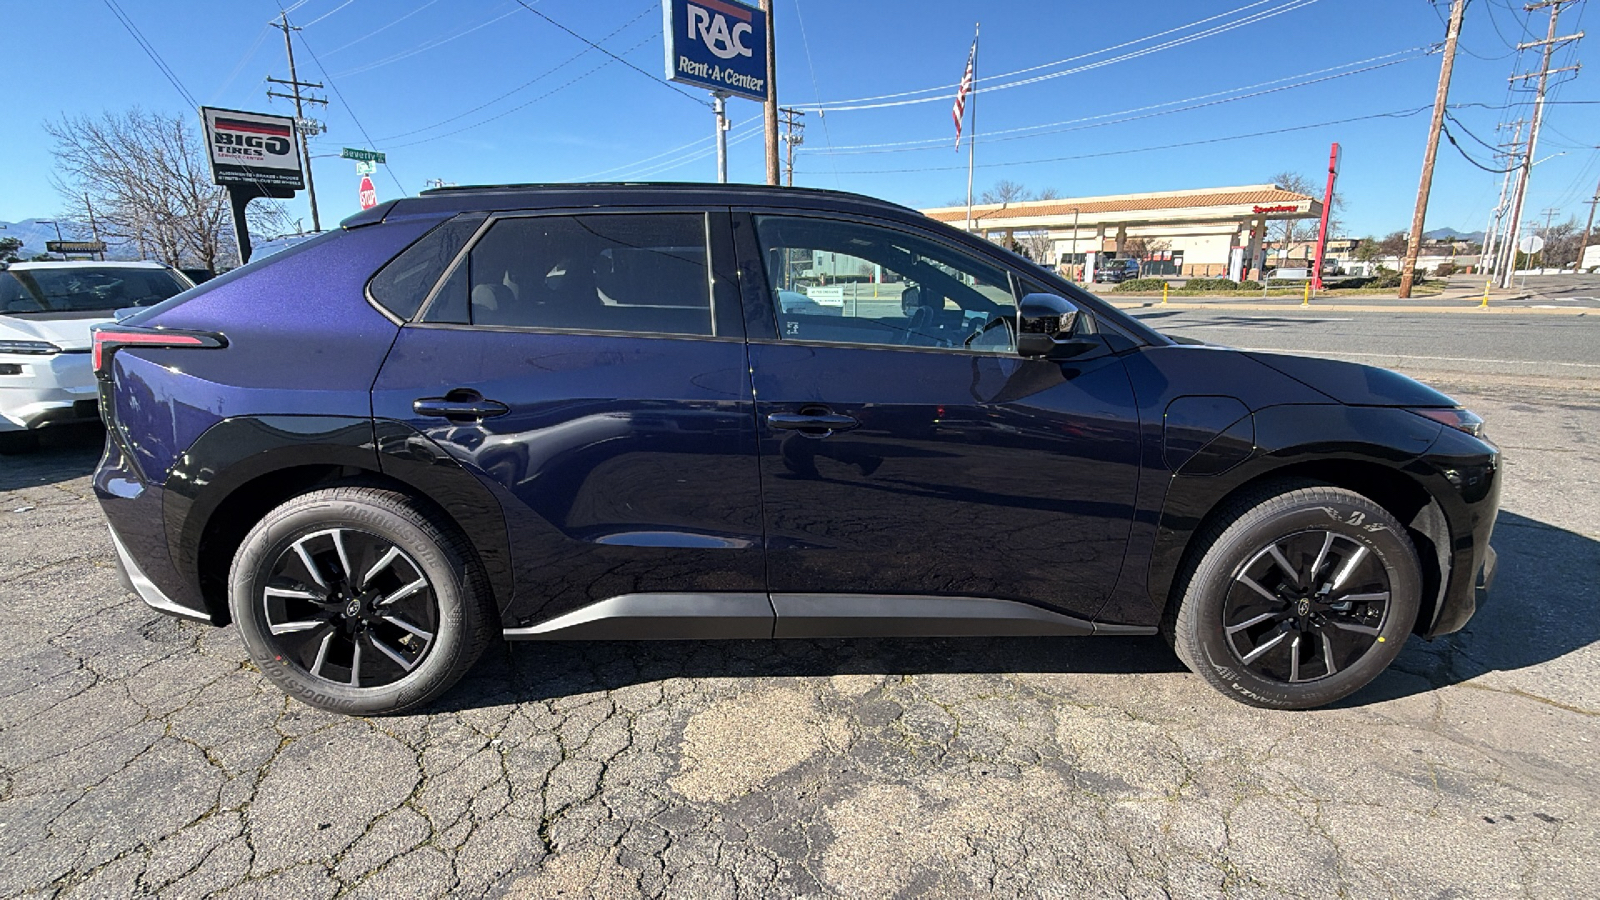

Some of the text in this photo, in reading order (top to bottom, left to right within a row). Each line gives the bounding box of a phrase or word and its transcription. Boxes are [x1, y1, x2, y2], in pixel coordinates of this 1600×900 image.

[687, 3, 752, 59] RAC
[215, 132, 290, 155] BIG O
[215, 145, 263, 156] TIRES
[343, 148, 376, 160] Beverly
[361, 190, 375, 206] STOP
